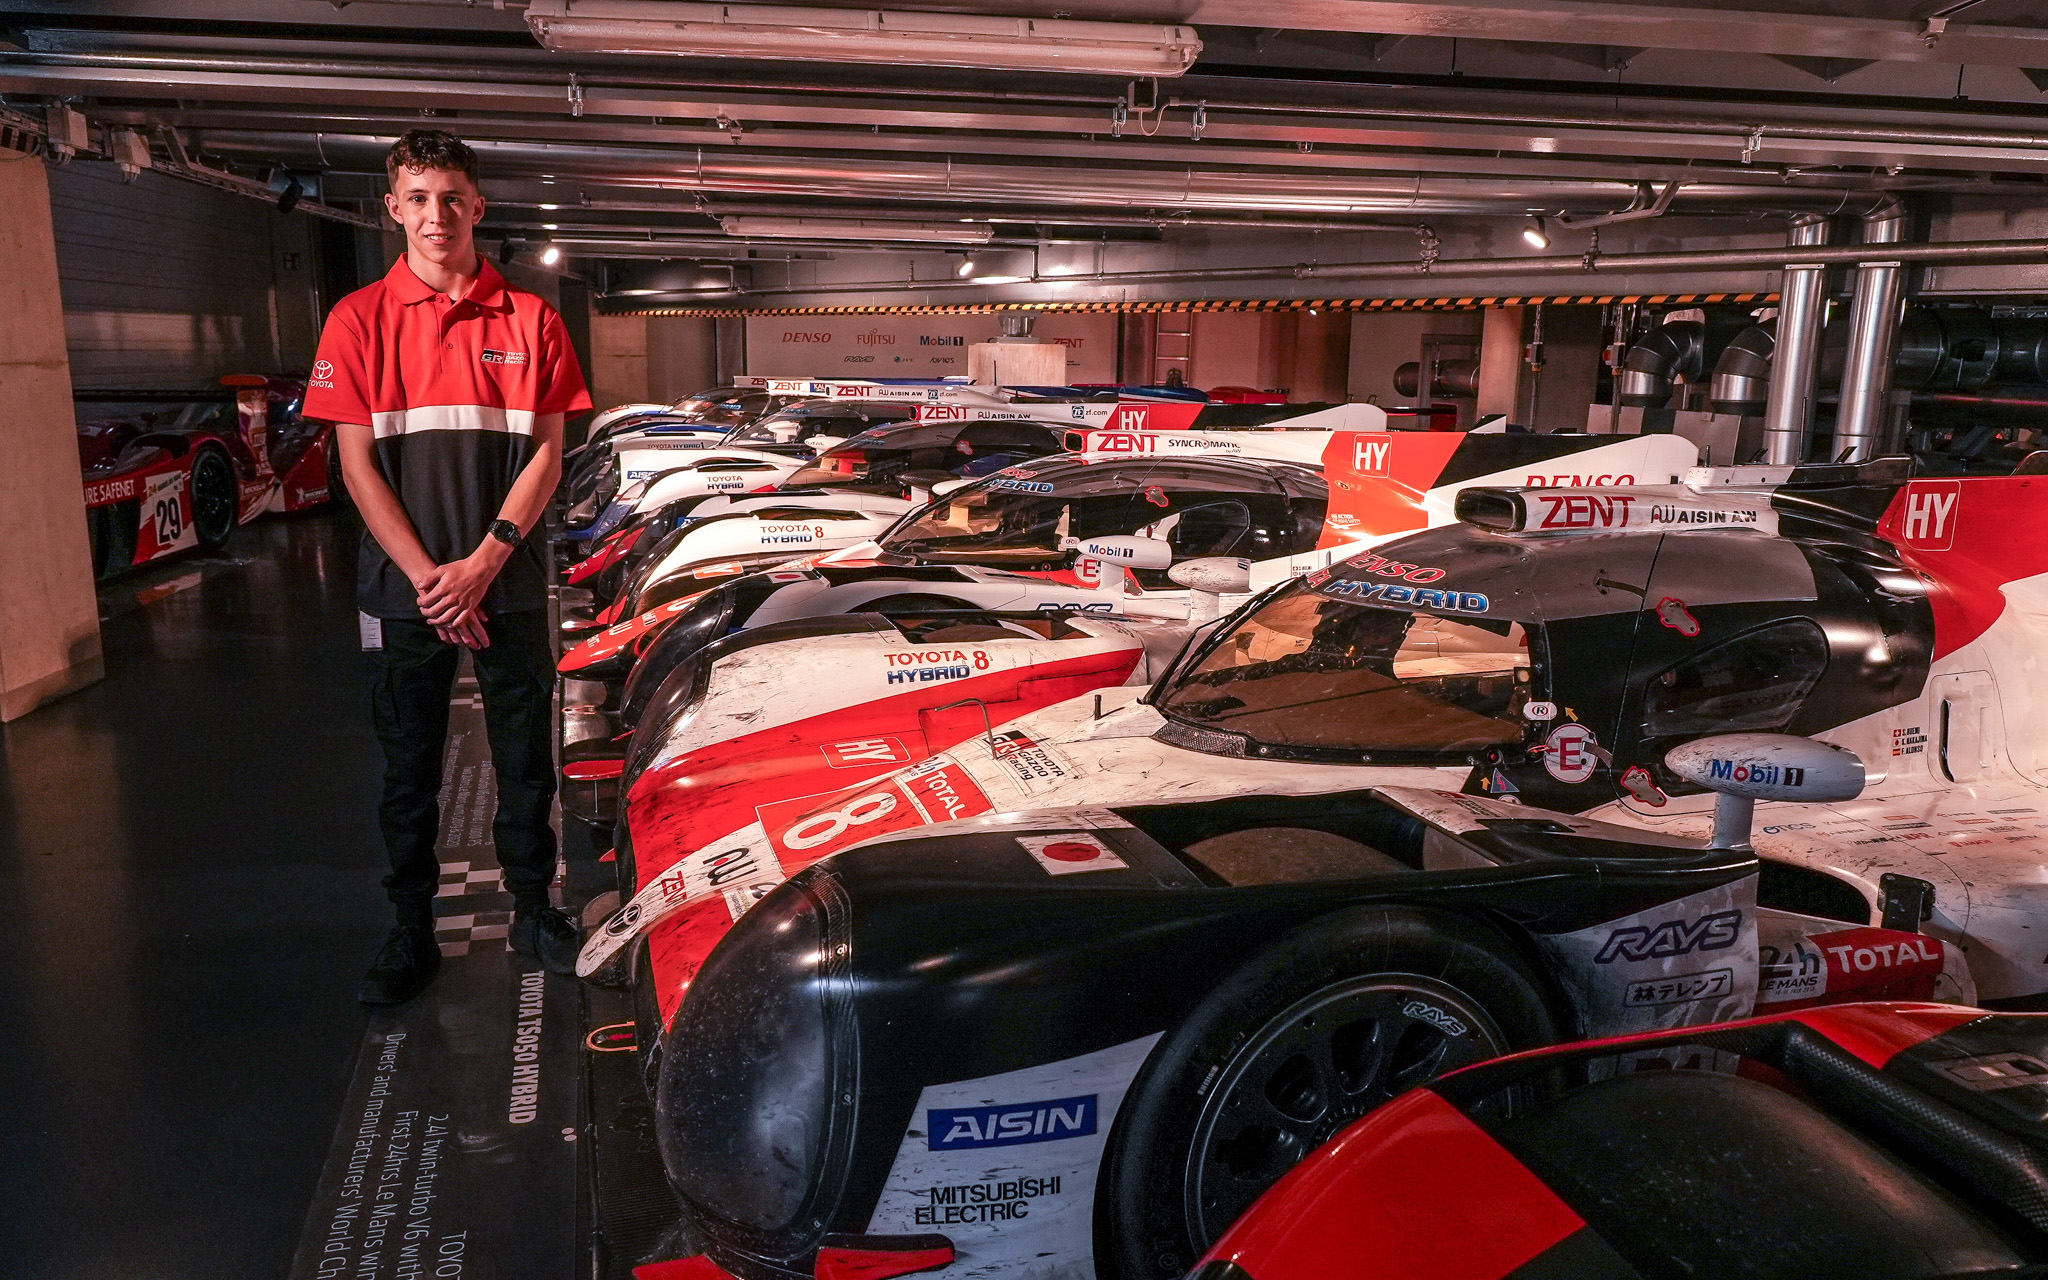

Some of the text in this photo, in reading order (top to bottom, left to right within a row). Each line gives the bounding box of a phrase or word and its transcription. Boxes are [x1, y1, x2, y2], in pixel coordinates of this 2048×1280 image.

[781, 332, 832, 343] DENSO
[856, 328, 896, 346] FUJITSU
[919, 335, 964, 346] Mobil 1
[481, 353, 503, 363] GR
[843, 355, 875, 363] RAYS
[774, 381, 802, 391] ZENT
[836, 386, 873, 397] ZENT
[924, 406, 971, 420] ZENT
[1121, 410, 1147, 430] HY
[1097, 433, 1160, 452] ZENT
[1354, 442, 1390, 471] HY
[99, 479, 136, 502] SAFENET
[707, 482, 744, 490] HYBRID
[156, 496, 182, 545] 29
[1538, 496, 1637, 529] ZENT
[1677, 510, 1727, 523] AISIN
[1730, 510, 1757, 523] AW
[1905, 492, 1957, 540] HY
[760, 524, 824, 538] TOYOTA 8
[761, 535, 813, 544] HYBRID
[1089, 544, 1134, 558] Mobil 1
[1083, 559, 1098, 578] E
[1323, 578, 1490, 613] HYBRID
[883, 650, 990, 671] TOYOTA 8
[886, 664, 971, 685] HYBRID
[835, 738, 897, 762] HY
[1018, 749, 1049, 777] GAZOO
[1031, 748, 1065, 777] TOYOTA
[1559, 737, 1583, 771] E
[1005, 753, 1034, 781] Racing
[1710, 759, 1804, 787] Mobil 1
[925, 770, 966, 821] TOTAL
[782, 792, 898, 851] 8
[661, 870, 688, 908] ZENT
[1595, 909, 1742, 965] RAYS
[1827, 939, 1939, 974] TOTAL
[1632, 974, 1728, 1002] 林テレンプ
[1777, 976, 1818, 989] MANS
[1402, 1001, 1468, 1037] RAYS
[508, 970, 545, 1125] TOYOTA TS050 HYBRID
[392, 1110, 419, 1140] First
[942, 1103, 1086, 1143] AISIN
[316, 1033, 407, 1280] Drivers' and manufacturers' World Ch
[381, 1141, 410, 1182] 24hrs
[375, 1182, 403, 1201] Le
[409, 1139, 444, 1216] twin-turbo
[929, 1175, 1061, 1206] MITSUBISHI
[363, 1203, 398, 1248] Mans
[914, 1201, 1029, 1226] ELECTRIC
[403, 1217, 433, 1240] V6
[396, 1243, 424, 1280] with
[435, 1230, 468, 1280] TOYO
